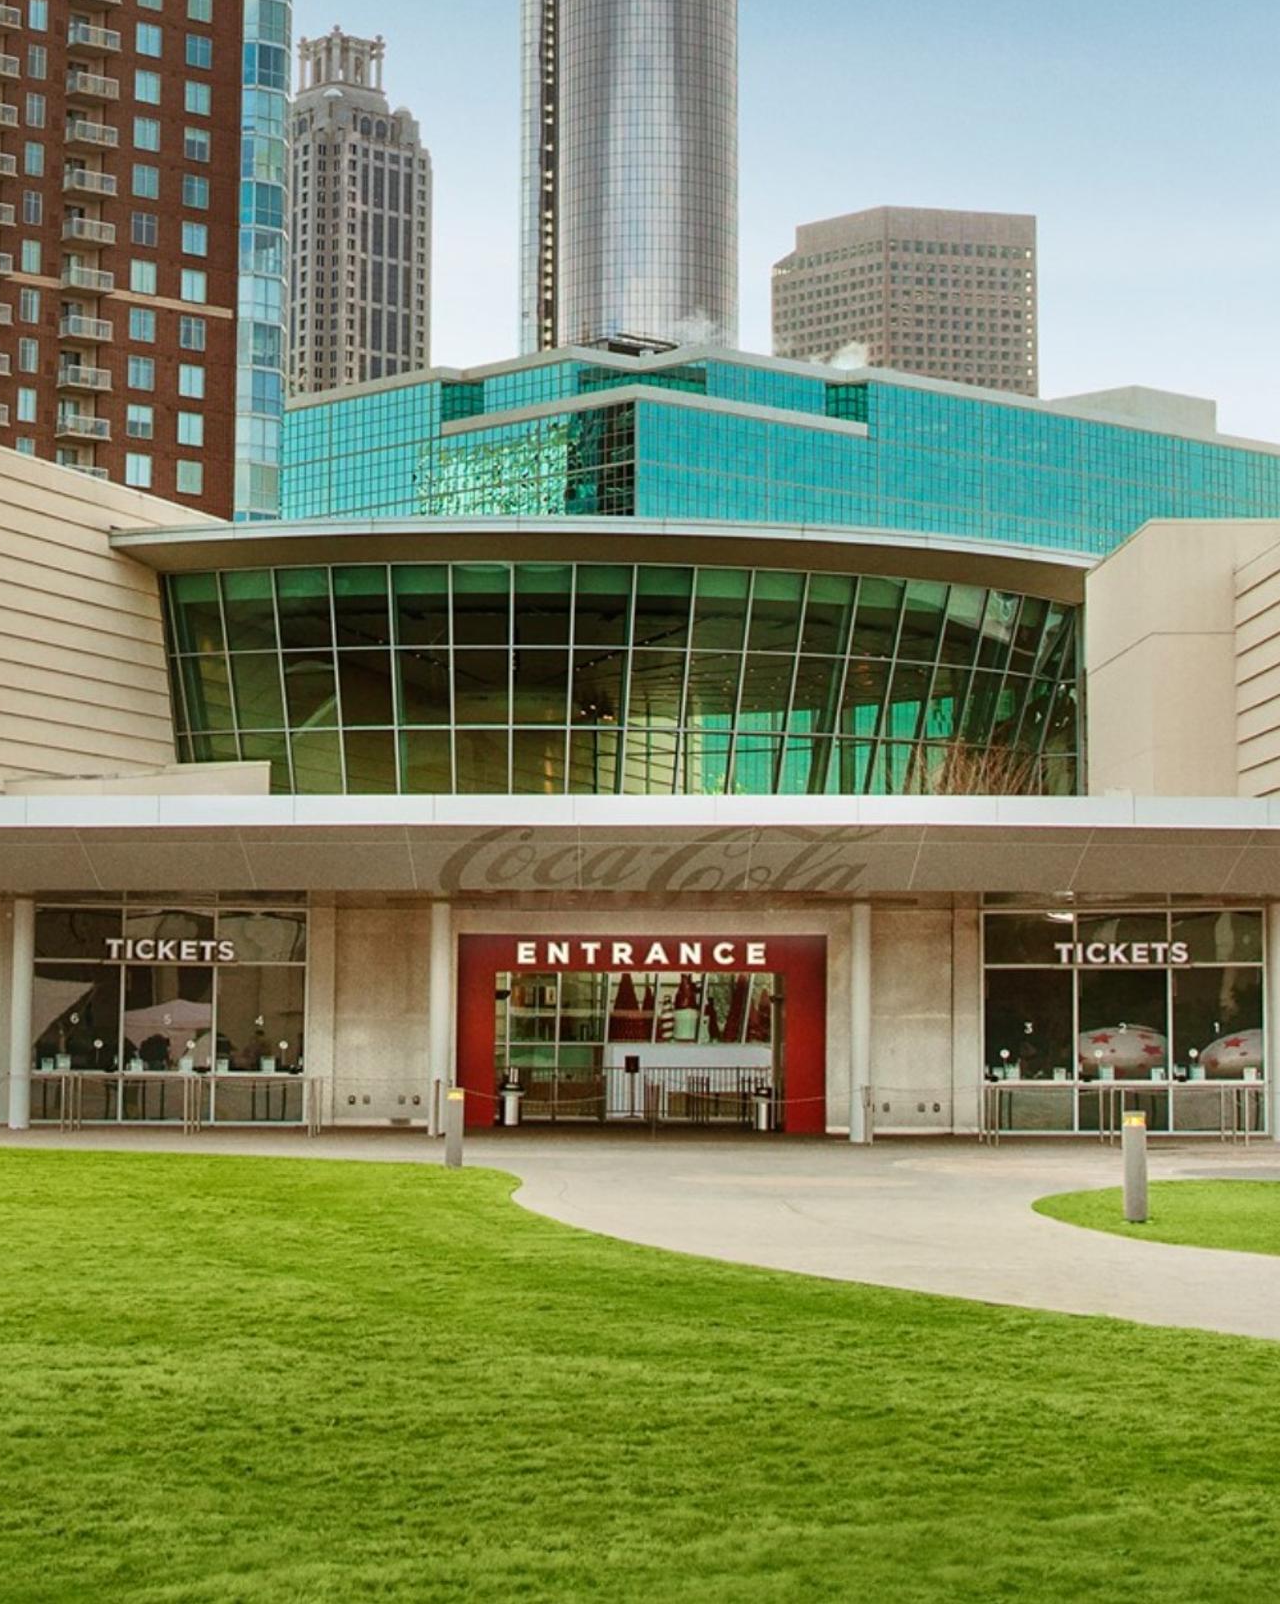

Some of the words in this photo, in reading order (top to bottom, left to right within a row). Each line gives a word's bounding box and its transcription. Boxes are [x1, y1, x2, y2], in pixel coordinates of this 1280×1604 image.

[105, 938, 235, 961] TICKETS
[517, 942, 767, 965] ENTRANCE
[1054, 942, 1189, 964] TICKETS
[69, 1012, 80, 1024] 6
[163, 1013, 172, 1025] 5
[255, 1014, 265, 1026] 4
[1024, 1022, 1033, 1034] 3
[1118, 1022, 1128, 1034] 2
[1213, 1021, 1220, 1033] 1
